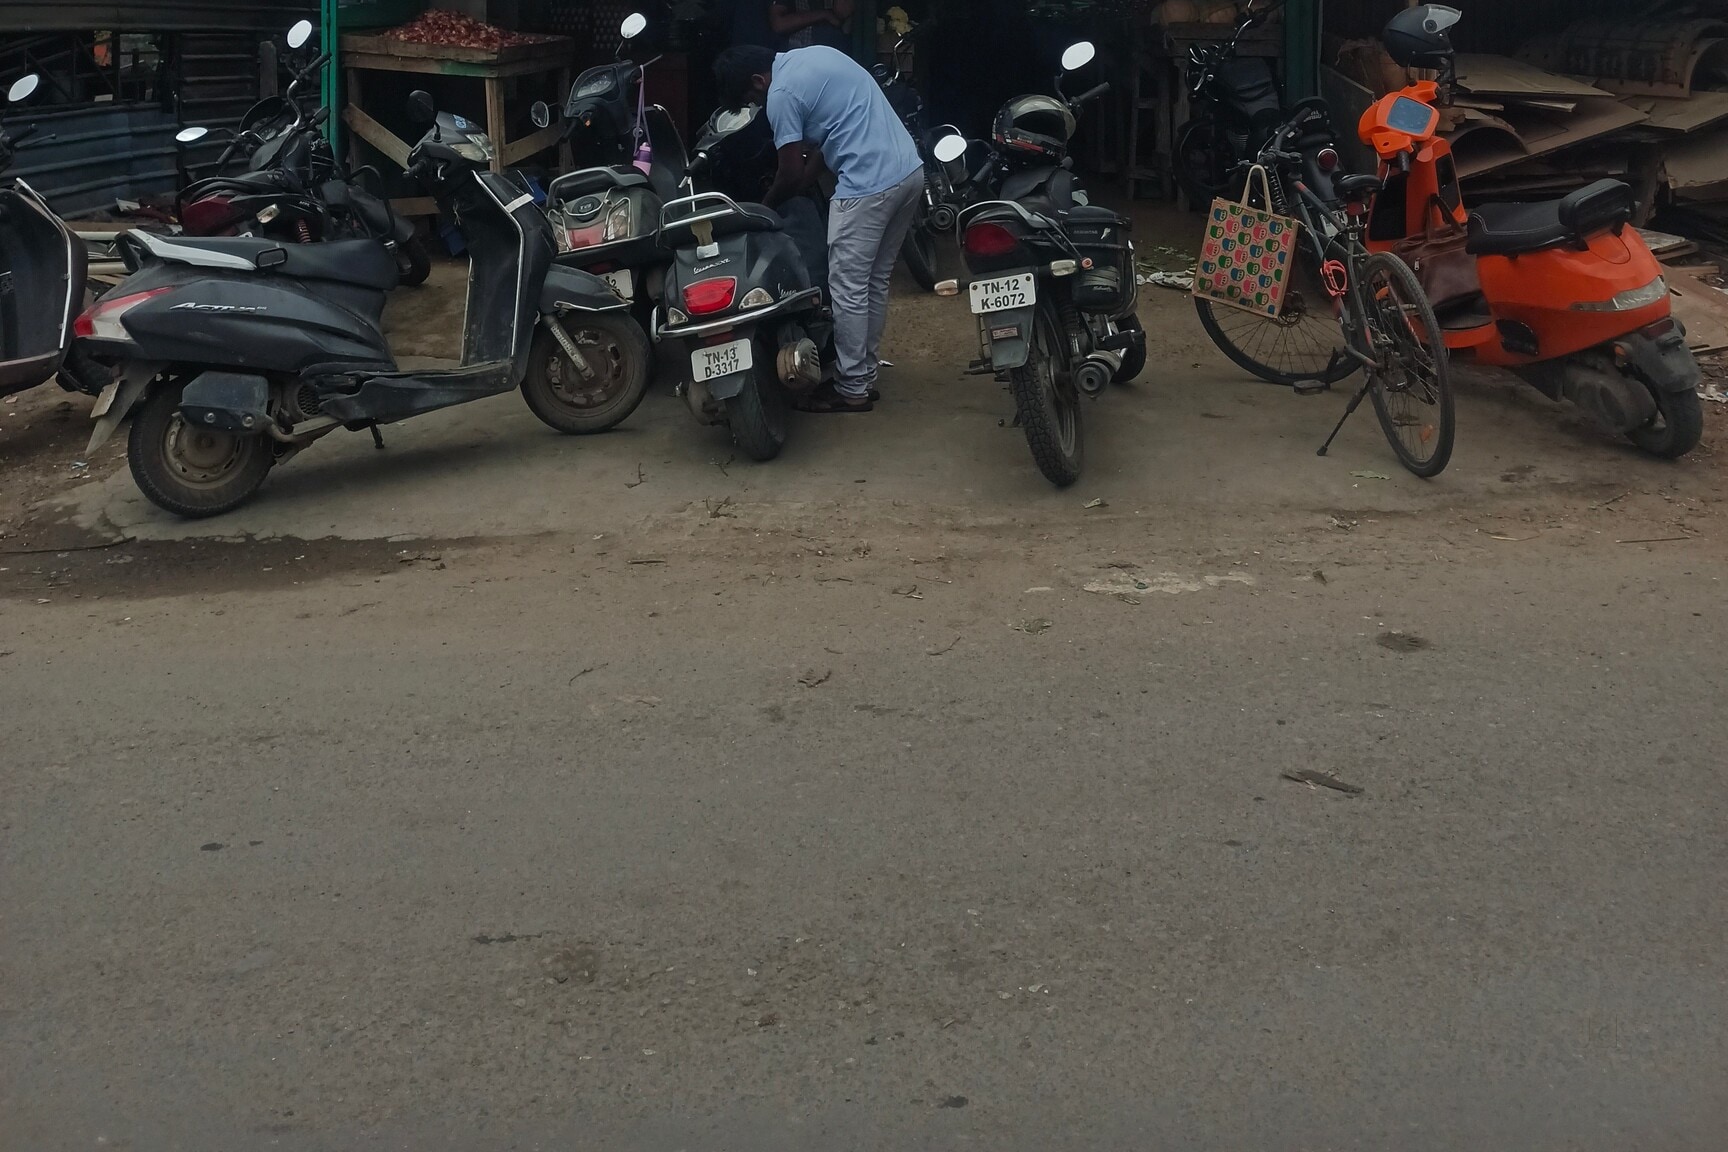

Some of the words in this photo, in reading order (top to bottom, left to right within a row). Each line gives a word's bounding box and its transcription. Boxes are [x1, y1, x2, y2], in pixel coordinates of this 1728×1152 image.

[982, 279, 1020, 295] TN-12
[981, 293, 1025, 310] K-6072
[704, 348, 737, 365] TN-13
[704, 358, 739, 378] D-3317
